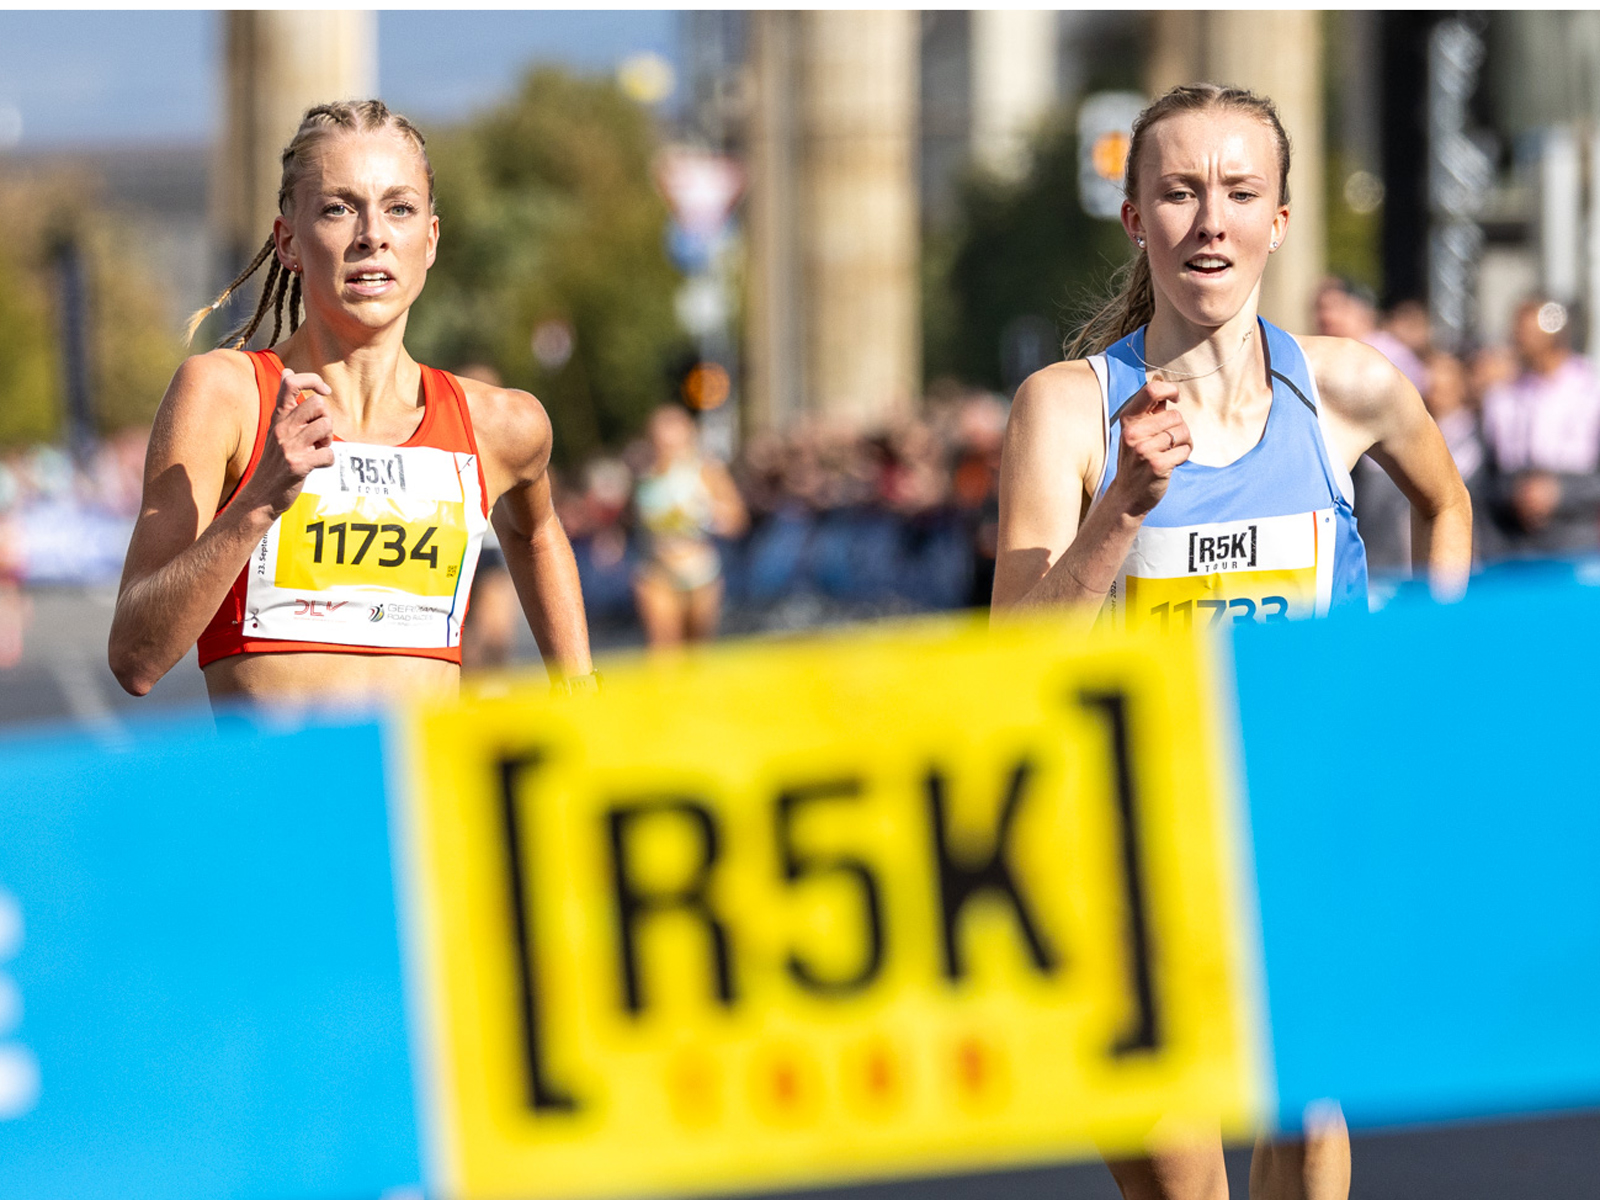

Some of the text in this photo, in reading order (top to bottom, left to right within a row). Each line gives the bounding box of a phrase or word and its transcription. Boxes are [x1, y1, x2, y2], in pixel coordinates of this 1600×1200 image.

[306, 521, 438, 568] 11734
[257, 563, 266, 575] 23.
[1205, 561, 1238, 572] TOUR
[1150, 596, 1290, 631] 11733
